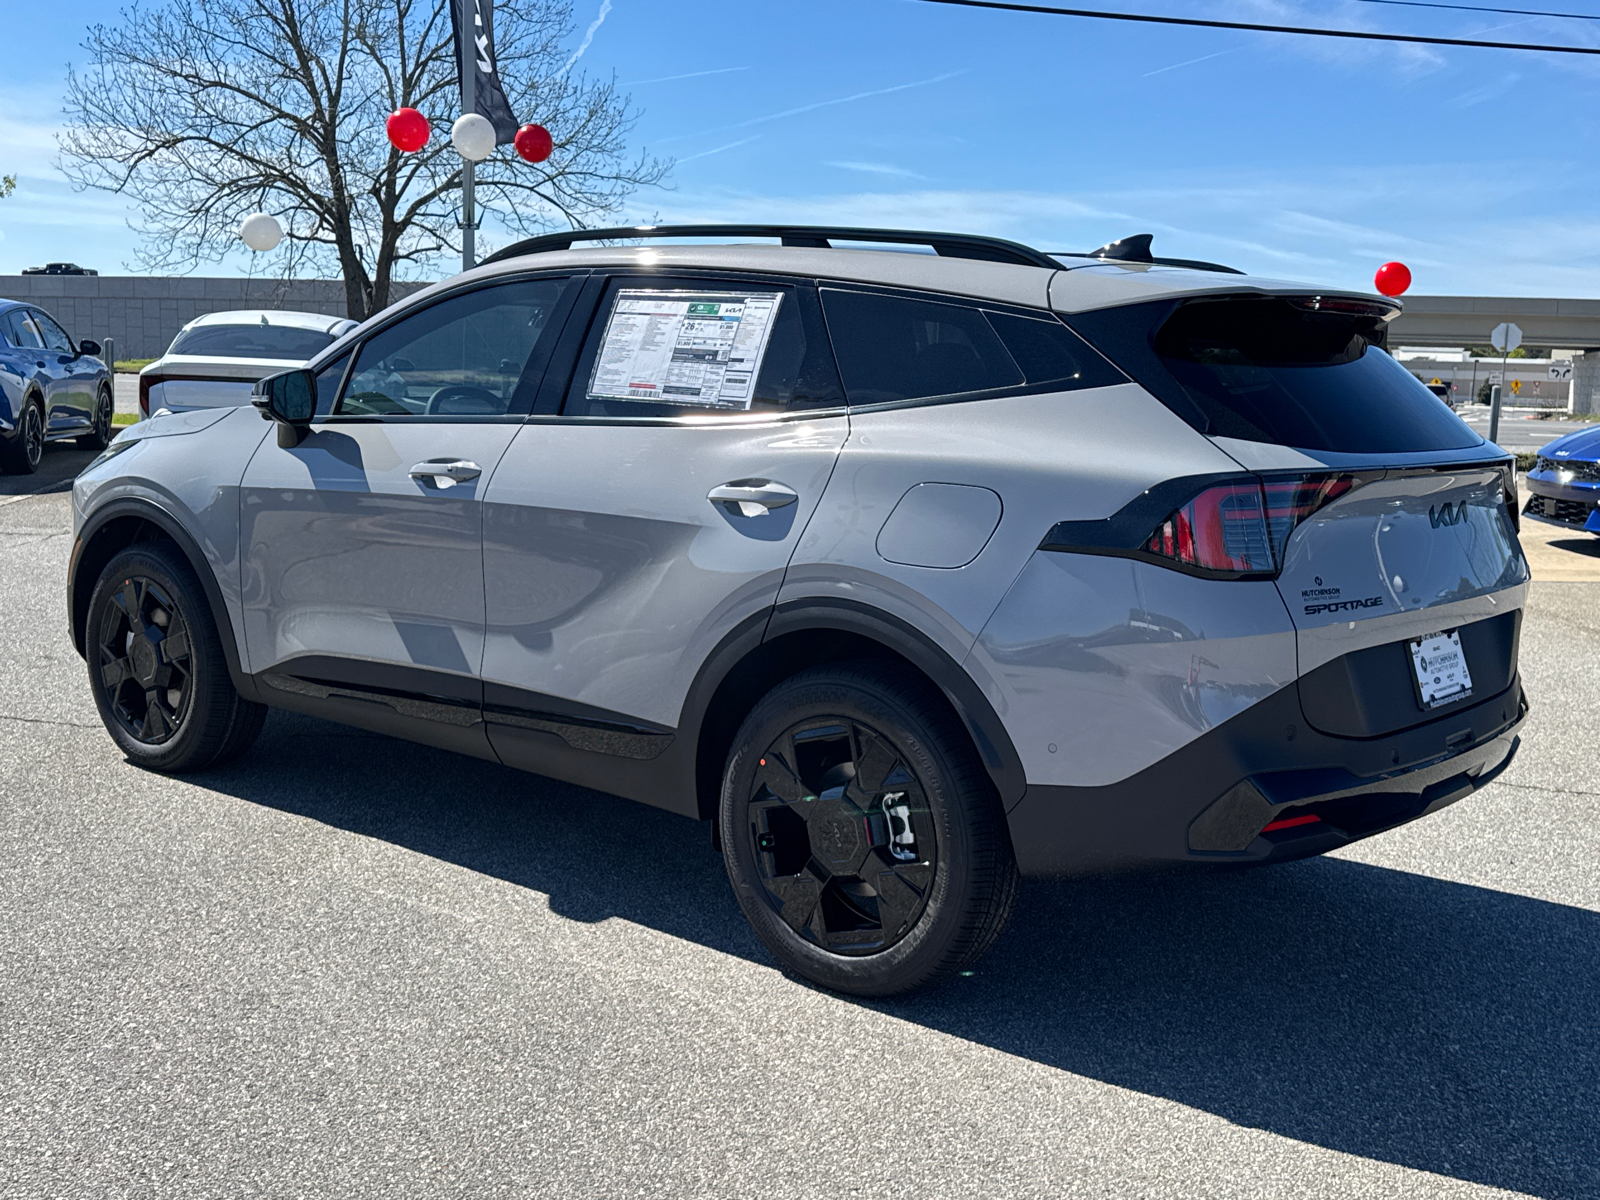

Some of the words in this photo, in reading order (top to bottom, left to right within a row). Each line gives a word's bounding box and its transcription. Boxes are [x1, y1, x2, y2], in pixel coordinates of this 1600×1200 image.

[685, 322, 695, 330] 26
[1429, 499, 1468, 529] KIA
[1301, 587, 1341, 597] HUTCHINSON
[1304, 596, 1384, 615] SPORTAGE
